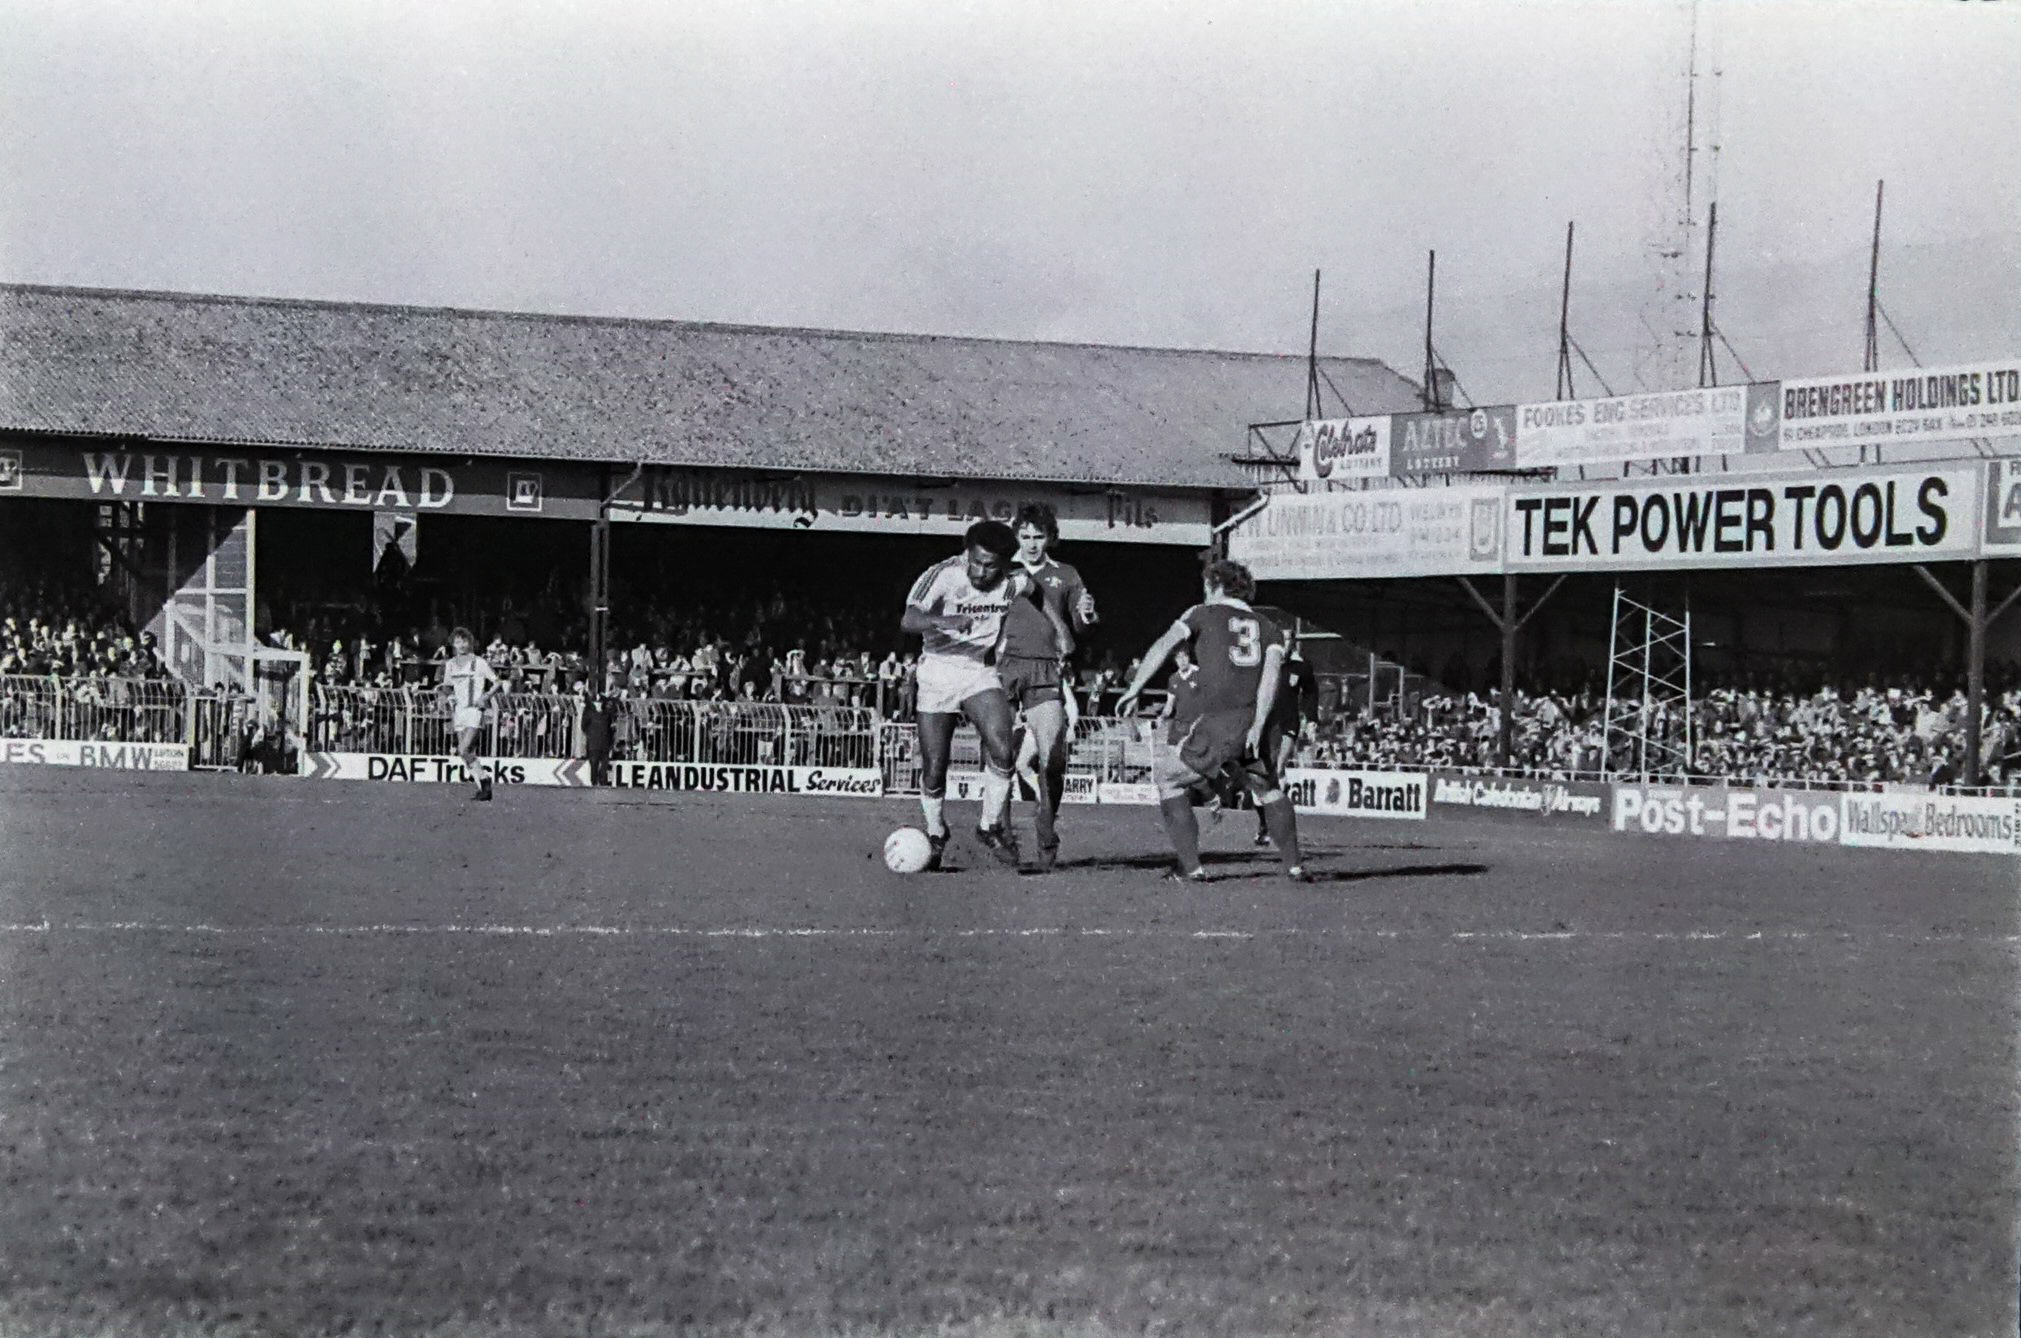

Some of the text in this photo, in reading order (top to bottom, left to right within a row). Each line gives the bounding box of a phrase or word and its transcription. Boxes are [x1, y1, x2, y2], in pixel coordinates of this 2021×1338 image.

[1892, 373, 1980, 411] HOLDINGS
[83, 452, 456, 509] WHITBREAD
[1515, 496, 1600, 556] TEK
[1612, 488, 1776, 554] POWER
[1784, 476, 1949, 551] TOOLS
[1229, 617, 1261, 666] 3
[80, 745, 152, 769] BMW
[368, 756, 428, 782] DAF
[806, 770, 881, 794] Services
[1348, 777, 1421, 812] Barratt
[1614, 789, 1838, 842] Post-Echo
[1925, 802, 2012, 840] Bedrooms
